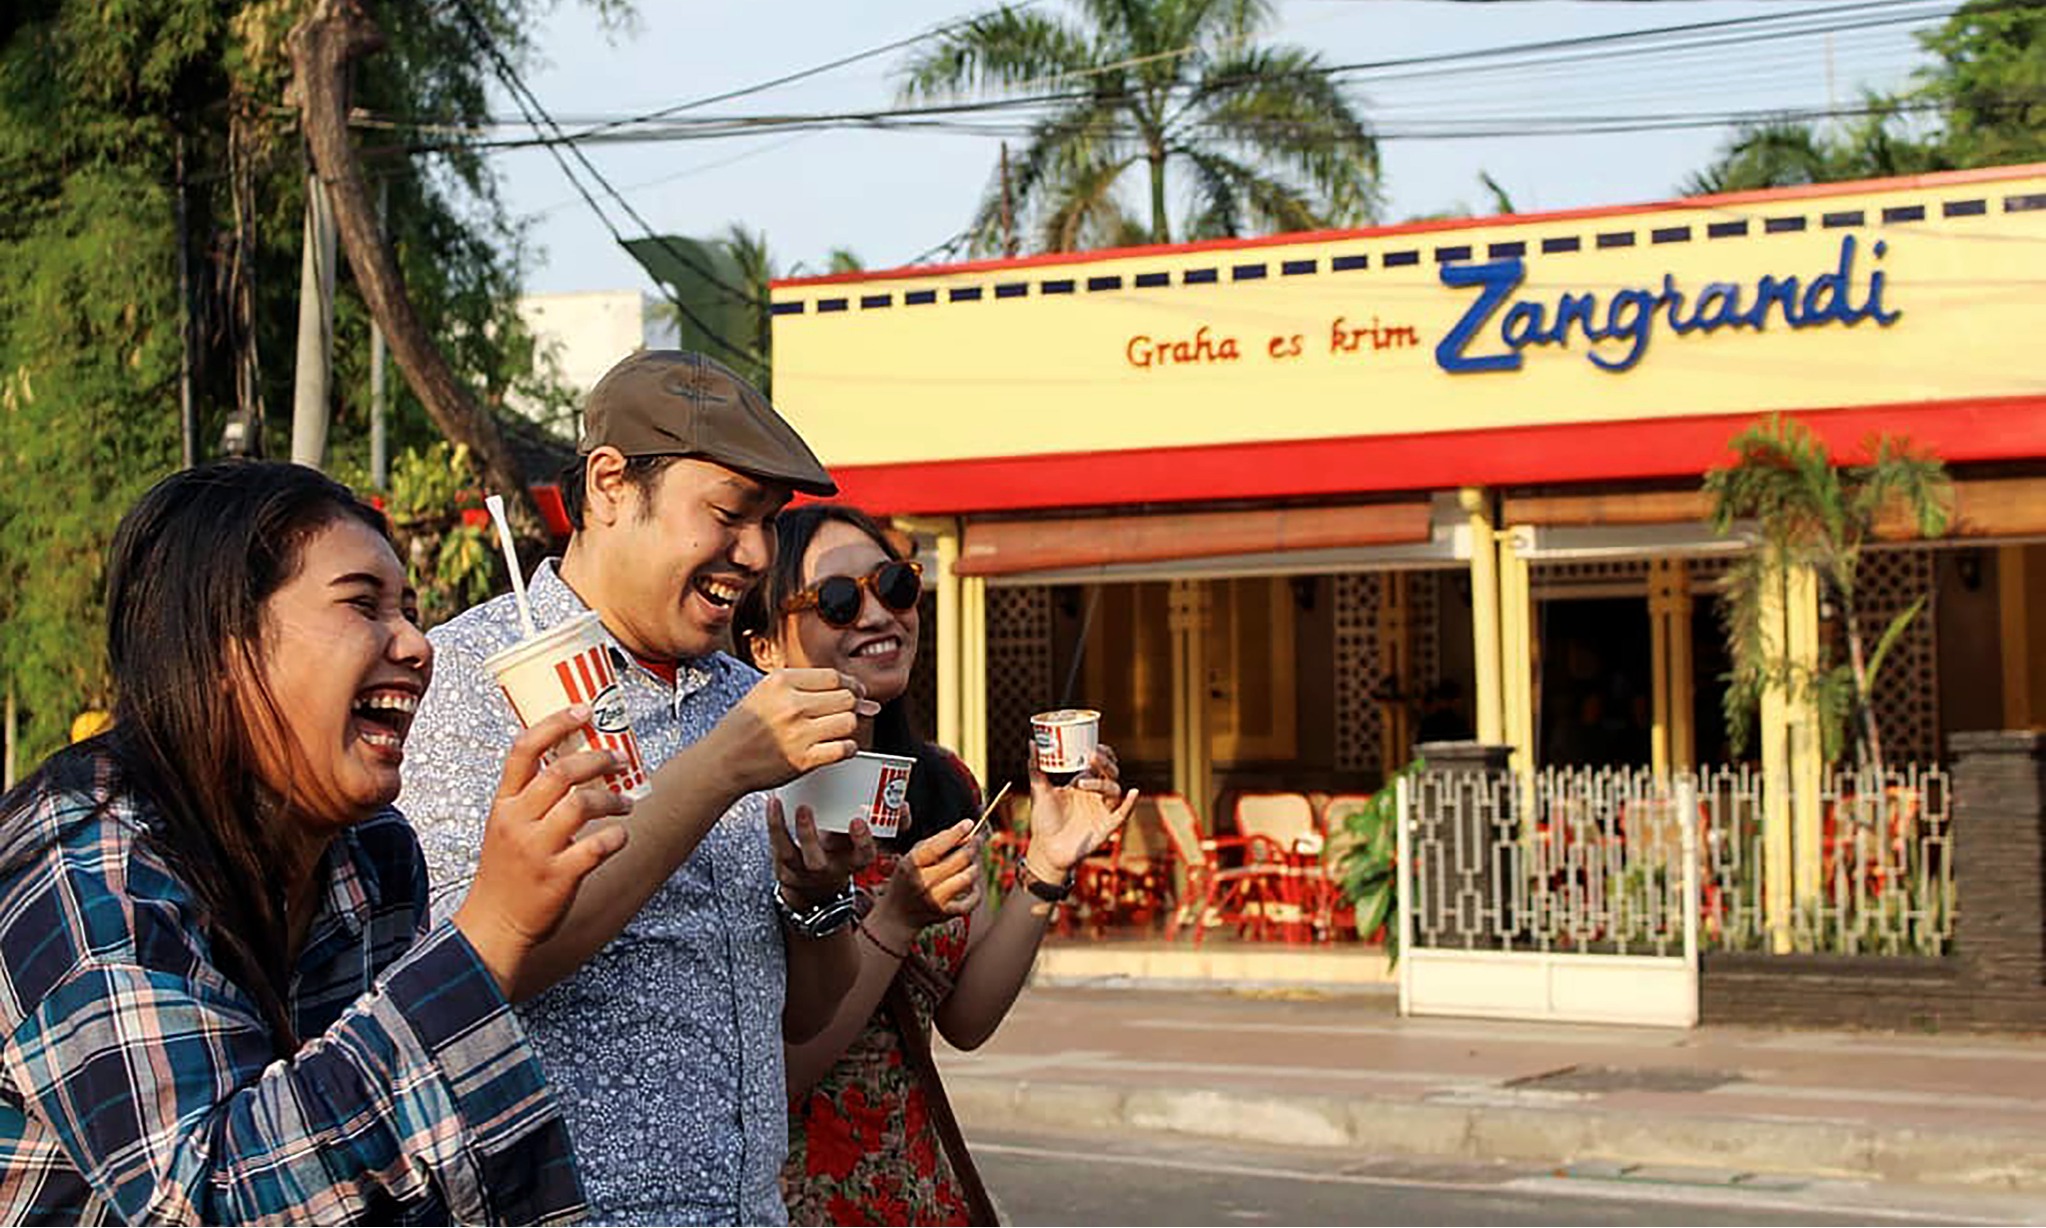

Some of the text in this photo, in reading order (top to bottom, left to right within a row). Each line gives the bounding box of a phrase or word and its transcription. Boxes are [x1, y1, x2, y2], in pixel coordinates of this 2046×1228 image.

[1126, 316, 1419, 368] Graha es krim
[1435, 234, 1901, 373] Zangrandi
